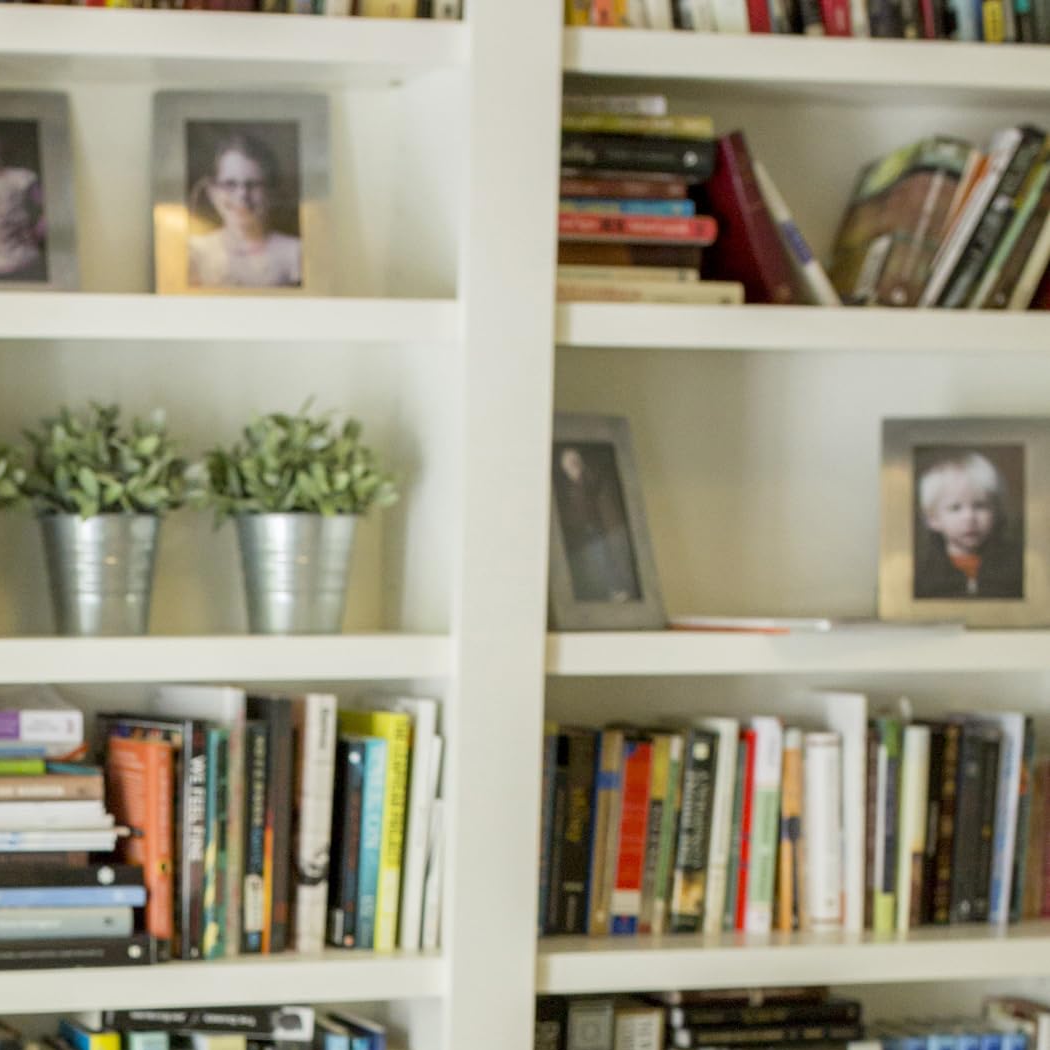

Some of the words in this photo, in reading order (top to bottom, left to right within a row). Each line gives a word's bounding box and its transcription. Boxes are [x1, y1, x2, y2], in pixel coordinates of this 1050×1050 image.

[190, 755, 207, 783] WE
[189, 785, 205, 823] FEEL
[188, 825, 204, 861] FINE
